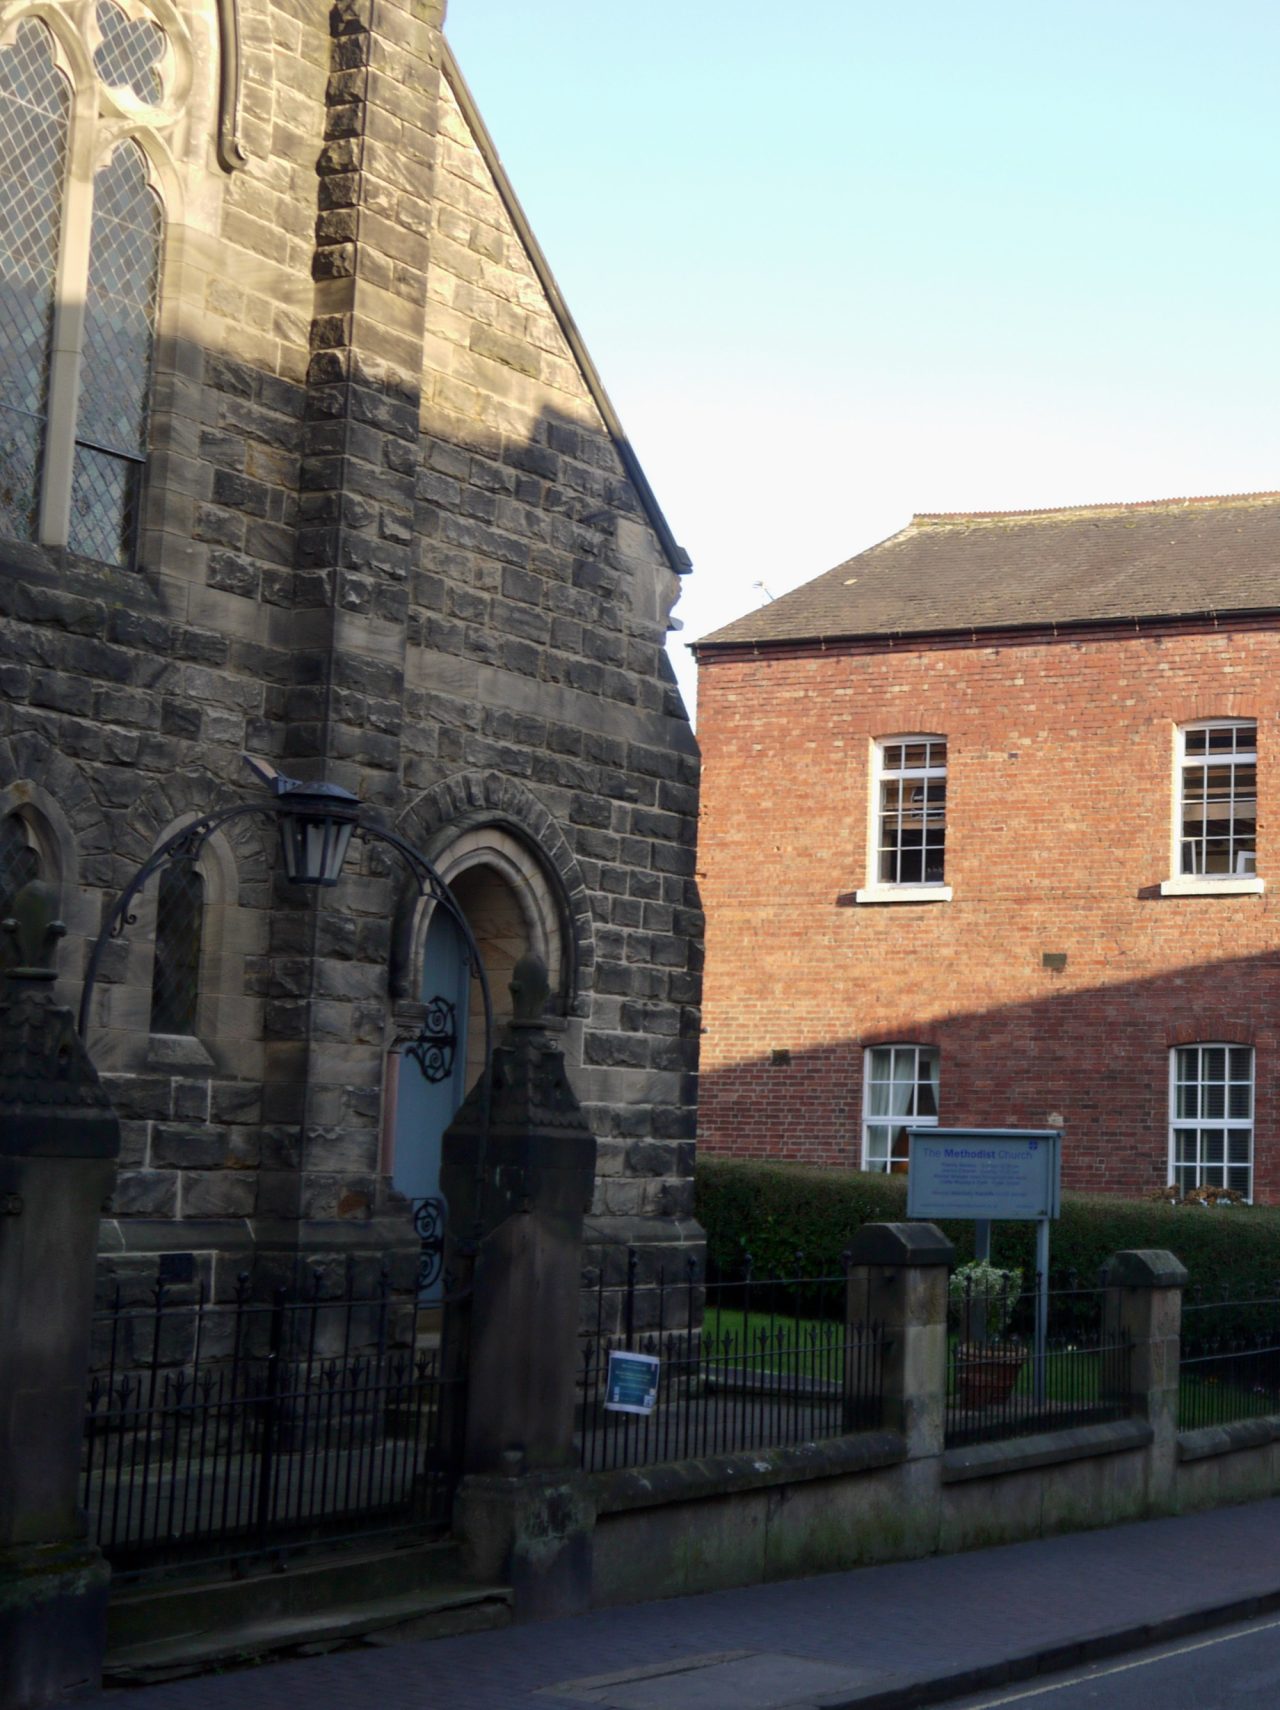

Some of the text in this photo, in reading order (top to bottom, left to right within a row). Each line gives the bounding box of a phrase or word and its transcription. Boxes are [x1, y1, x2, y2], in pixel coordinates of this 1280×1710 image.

[924, 1148, 1033, 1160] The Methodist Church
